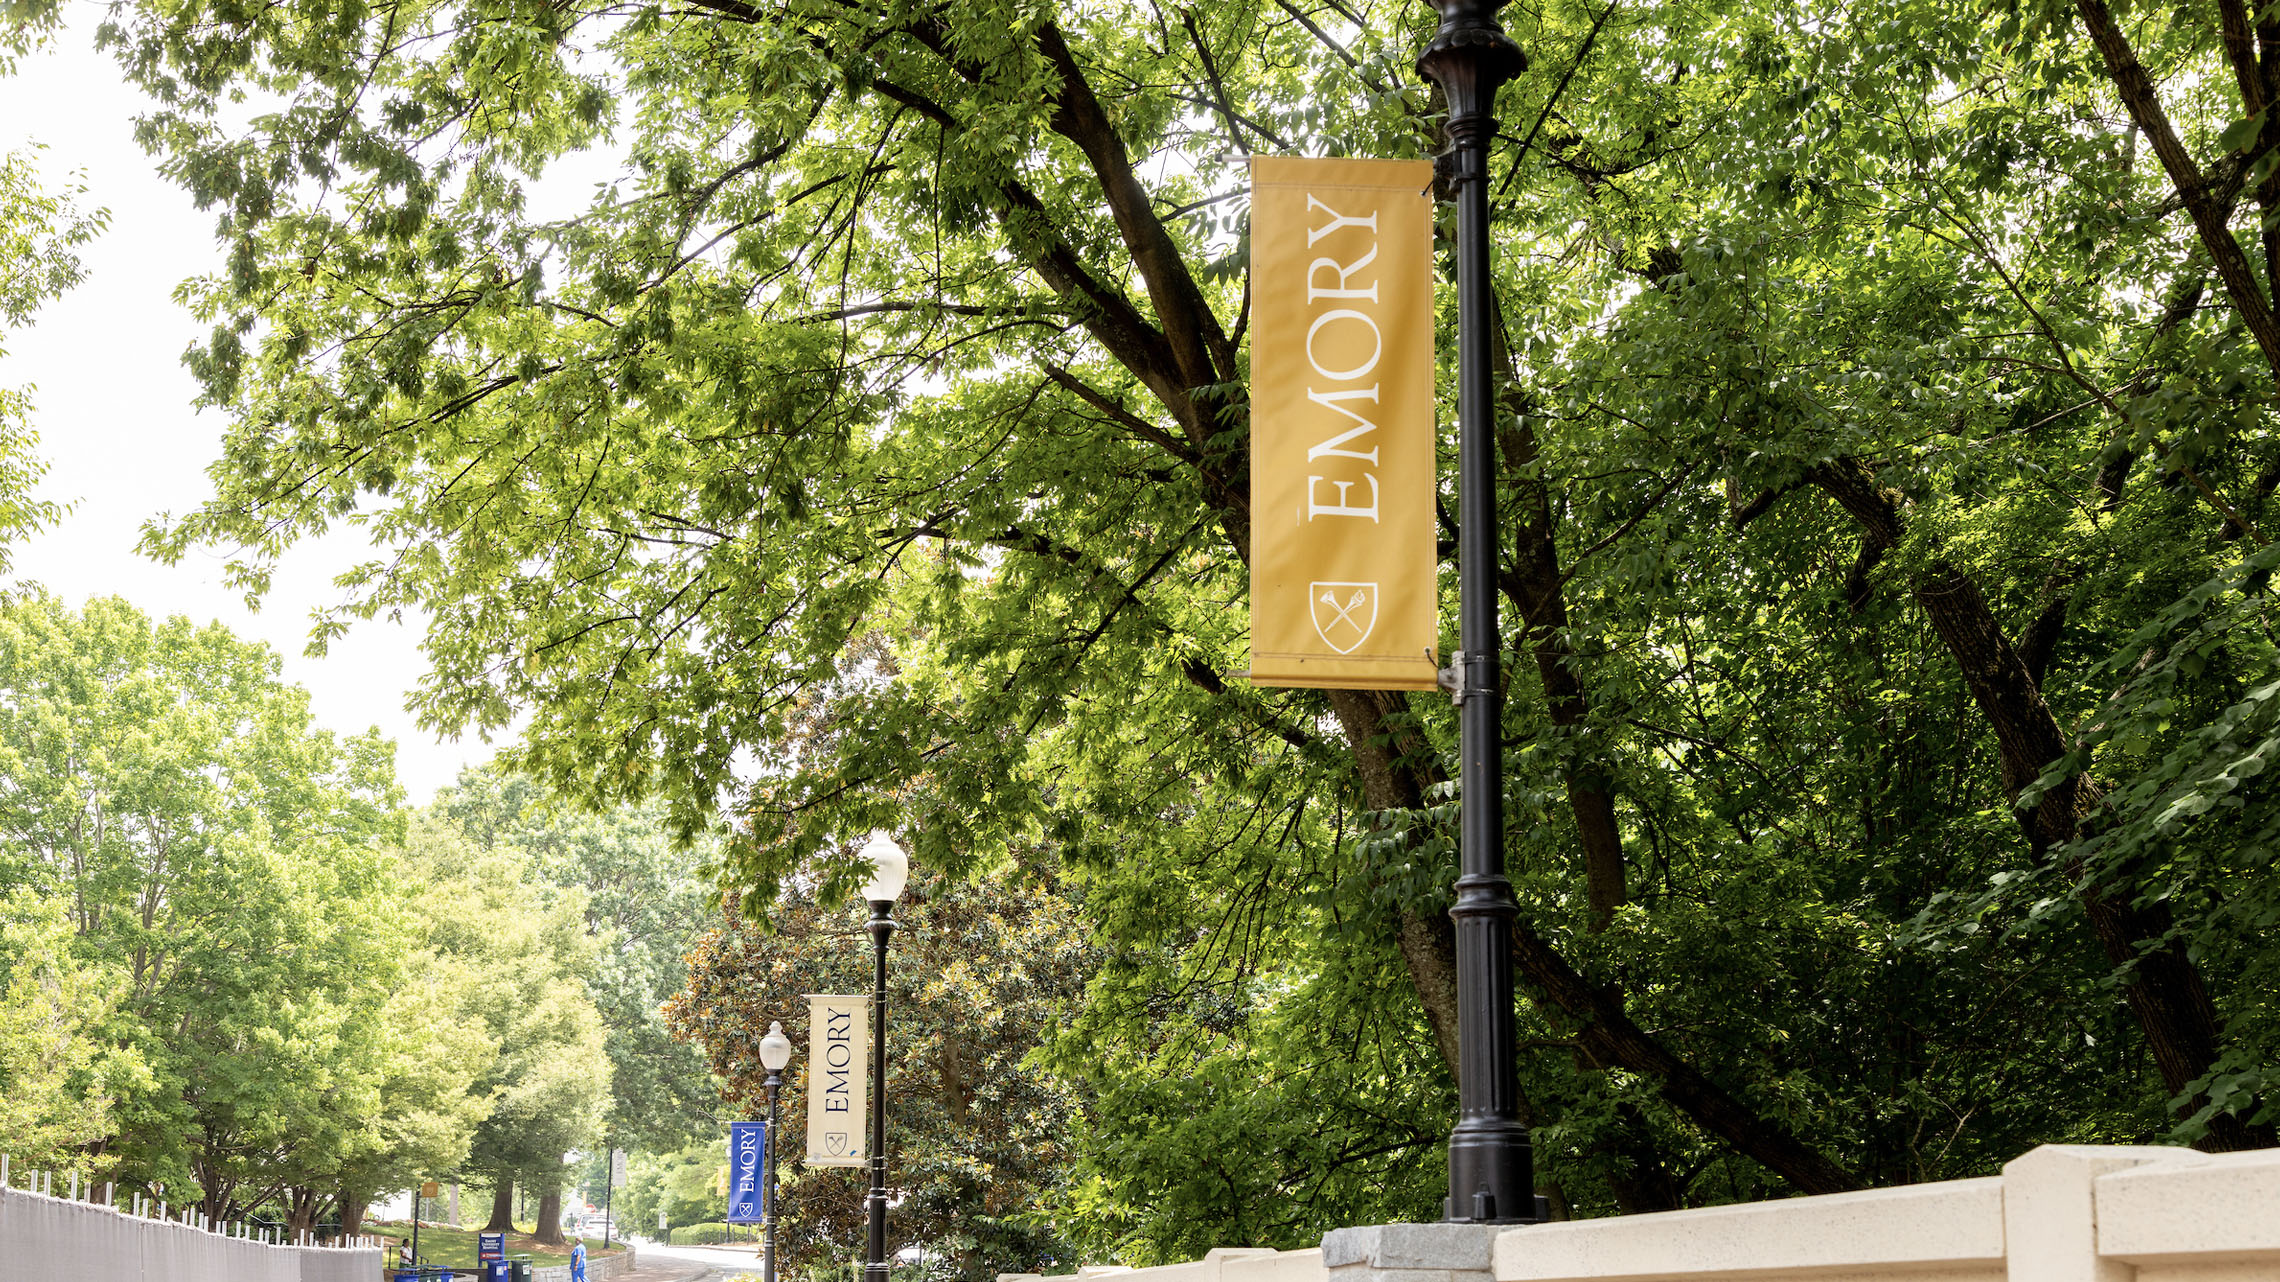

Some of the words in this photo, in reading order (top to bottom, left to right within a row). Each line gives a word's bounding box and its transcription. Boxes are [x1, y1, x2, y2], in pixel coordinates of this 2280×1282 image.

[1306, 193, 1382, 524] EMORY
[825, 1007, 851, 1113] EMORY
[740, 1128, 756, 1193] EMORY
